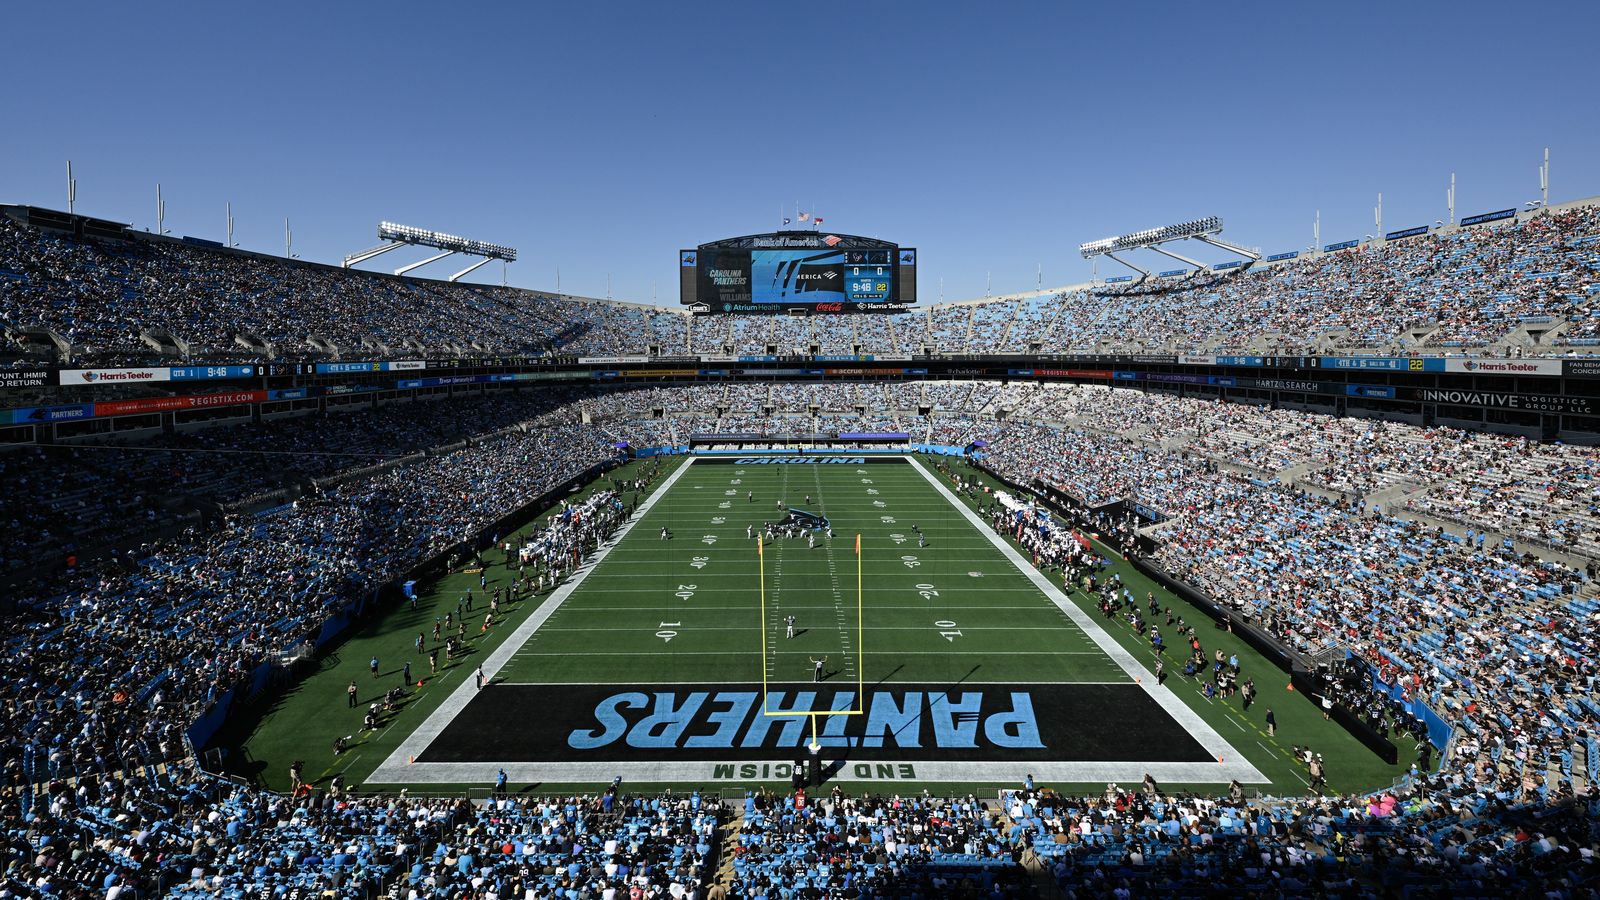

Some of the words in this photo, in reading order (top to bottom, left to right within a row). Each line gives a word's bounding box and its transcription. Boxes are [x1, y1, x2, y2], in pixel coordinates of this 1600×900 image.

[785, 238, 818, 247] America
[709, 270, 742, 278] CAROLINA
[853, 267, 859, 276] 0
[877, 267, 883, 276] 0
[713, 277, 747, 285] PANTHERS
[852, 283, 871, 292] 9:46
[876, 283, 886, 291] 22
[720, 293, 751, 301] WILLIAMS
[1266, 357, 1271, 366] 0
[1311, 358, 1316, 367] 0
[1338, 359, 1350, 367] 4TH
[1359, 359, 1366, 368] 15
[1409, 359, 1423, 370] 22
[207, 366, 227, 377] 9:46
[258, 366, 264, 376] 0
[307, 364, 313, 374] 0
[1479, 362, 1506, 371] Harris
[1506, 363, 1538, 372] Teeter
[23, 371, 47, 379] IHMIR
[100, 372, 127, 381] Harris
[127, 371, 153, 380] Teeter
[173, 369, 186, 377] QTR
[6, 379, 44, 387] RETURN.
[1285, 381, 1318, 391] SEARCH
[189, 393, 254, 406] REGISTIX.COM
[1423, 389, 1518, 408] INNOVATIVE
[1525, 396, 1586, 405] LOGISTICS
[1525, 403, 1563, 411] GROUP
[1570, 406, 1591, 414] LLC
[51, 409, 83, 419] PARTNERS
[734, 457, 865, 465] CAROLINA
[690, 557, 709, 567] 30
[901, 556, 920, 566] 30
[675, 584, 697, 597] 20
[916, 583, 939, 597] 20
[656, 621, 681, 638] 10
[935, 620, 963, 636] 10
[566, 691, 1047, 750] PANTHERS
[854, 763, 916, 779] END
